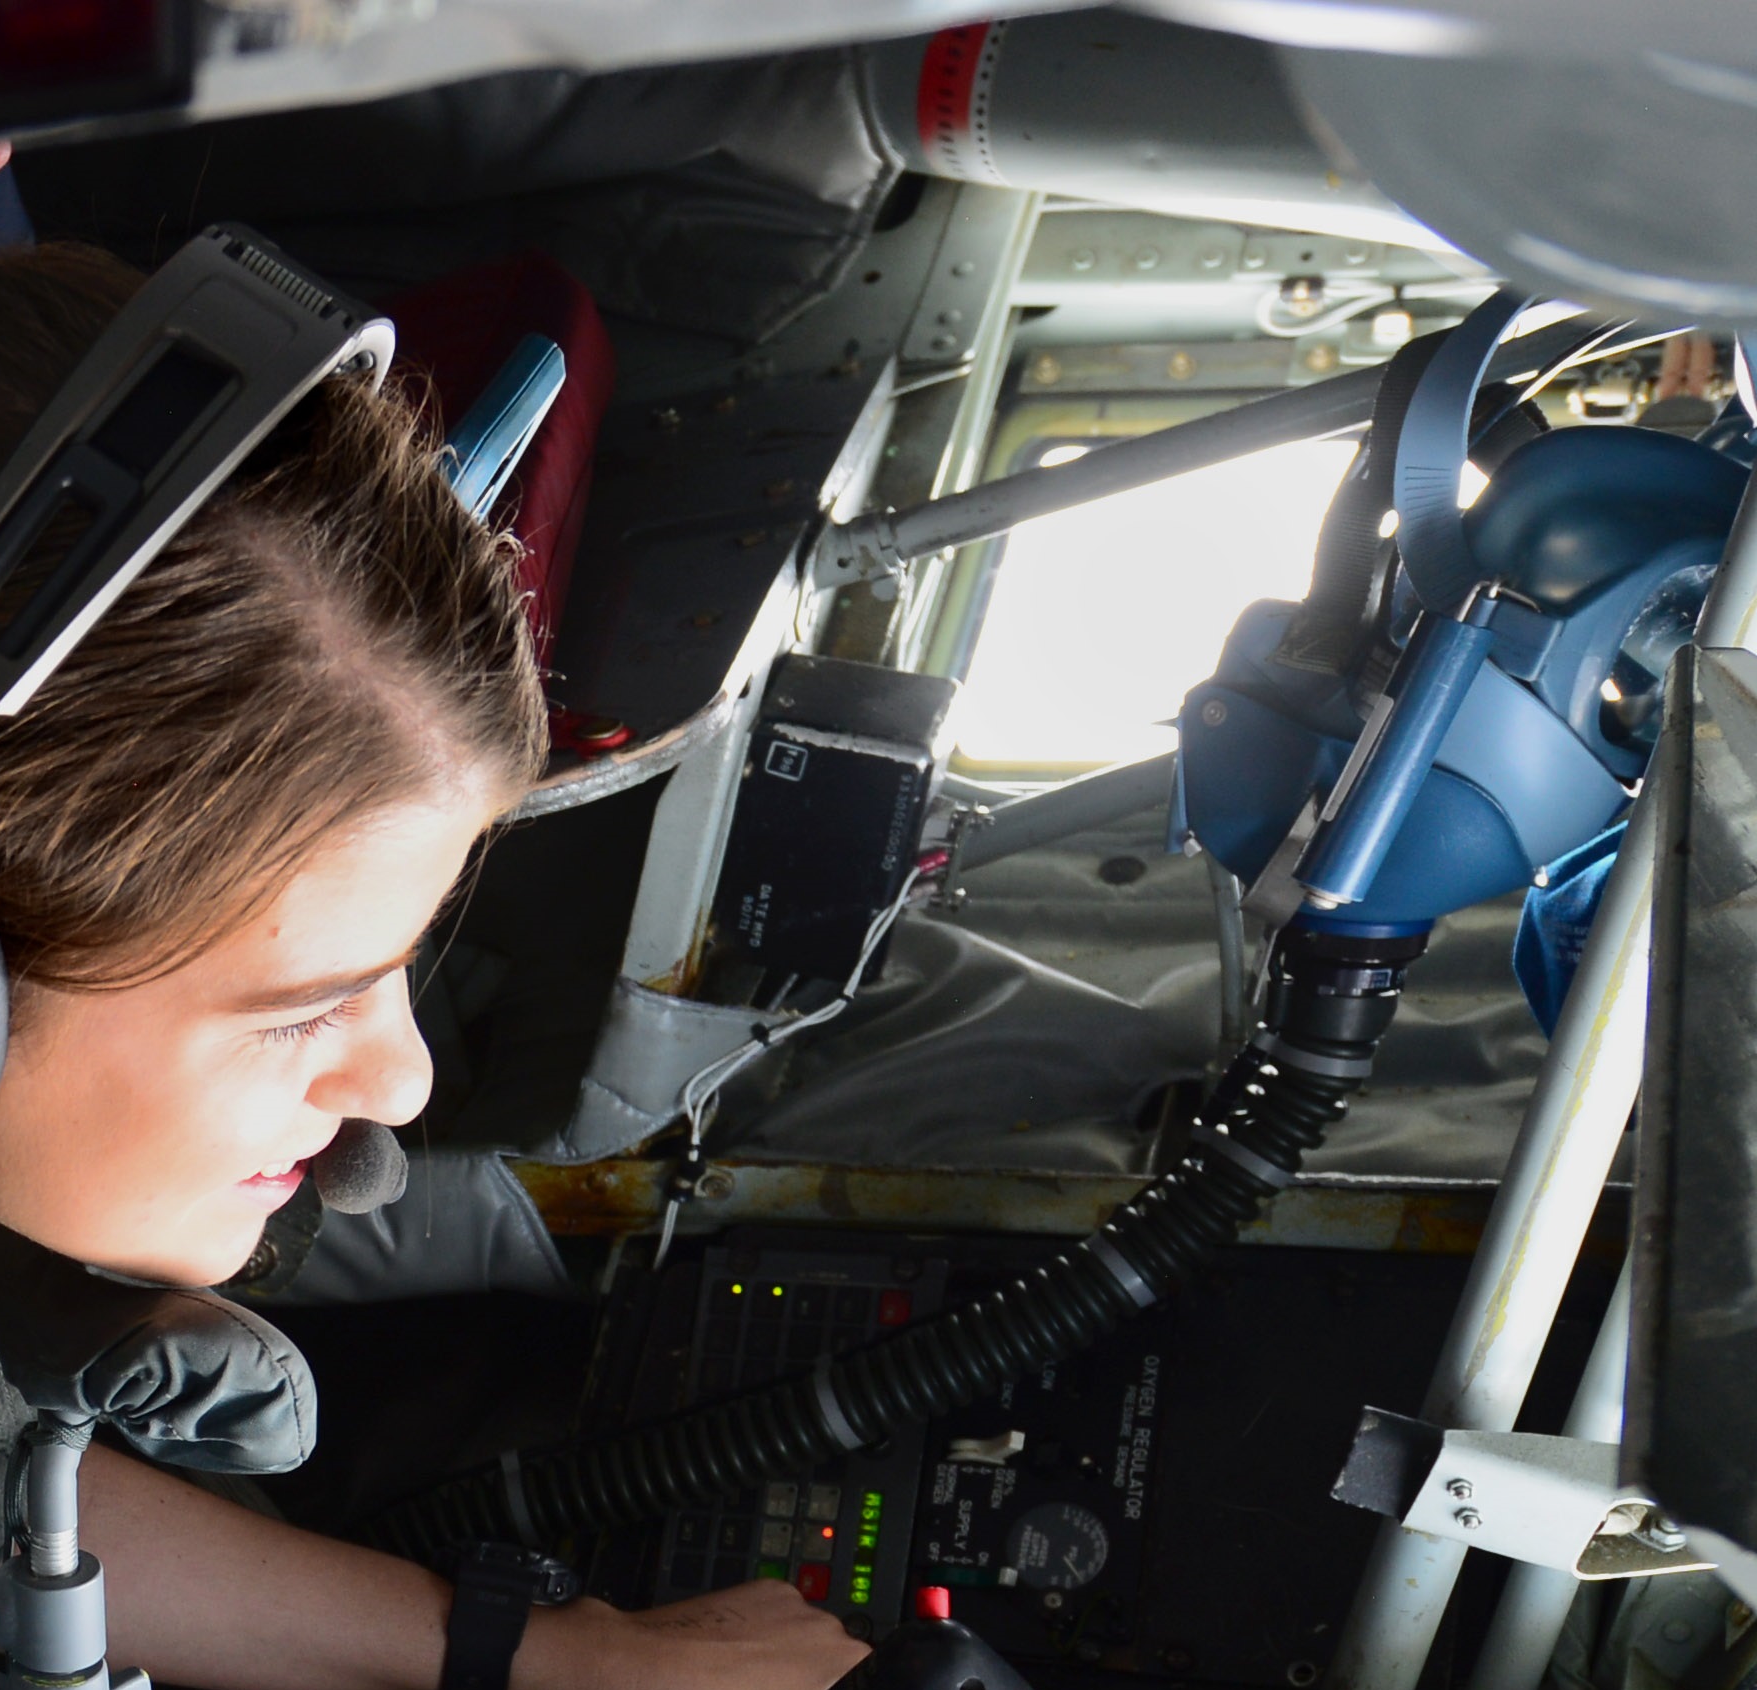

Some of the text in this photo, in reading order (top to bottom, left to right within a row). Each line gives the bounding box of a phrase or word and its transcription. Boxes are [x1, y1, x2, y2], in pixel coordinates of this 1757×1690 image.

[1119, 1384, 1137, 1438] PRESSURE
[1124, 1355, 1160, 1521] OXYGEN REGULATOR
[954, 1499, 973, 1550] SUPPLY
[928, 1541, 941, 1562] OFF
